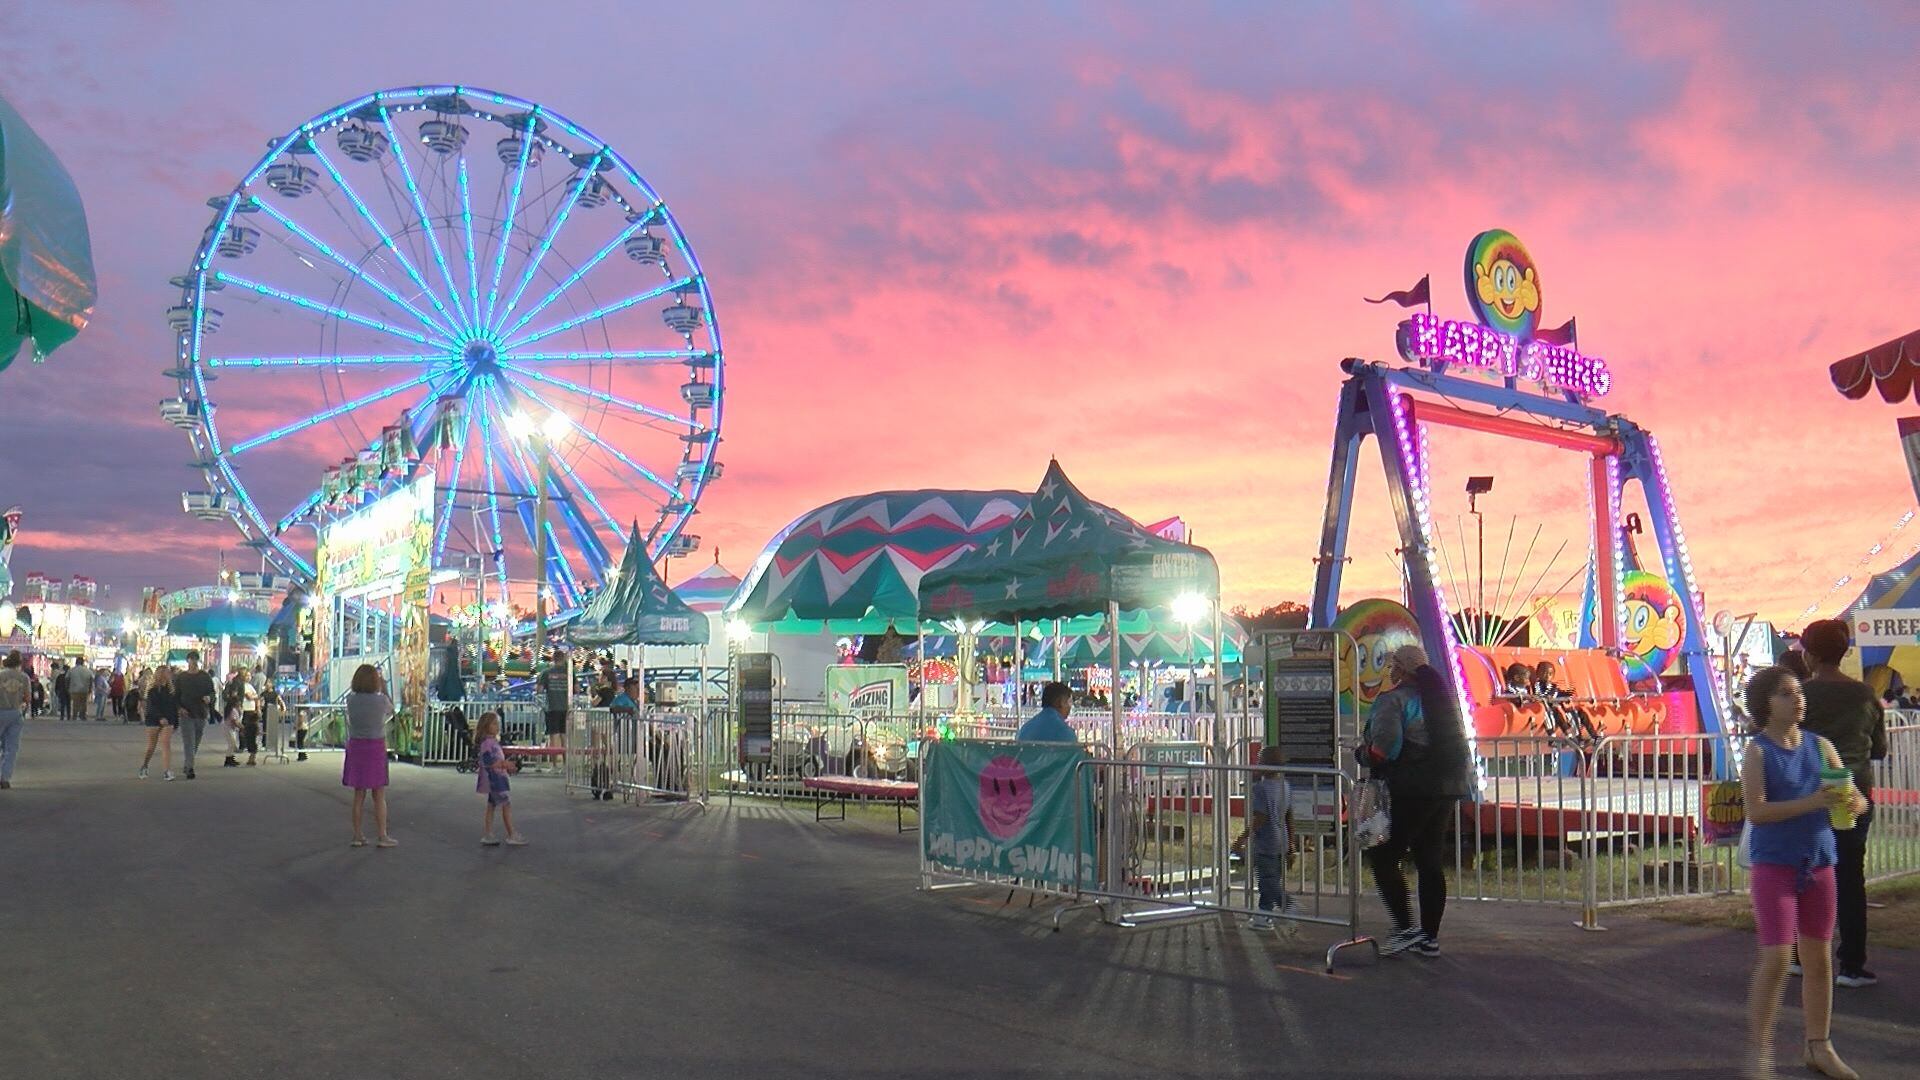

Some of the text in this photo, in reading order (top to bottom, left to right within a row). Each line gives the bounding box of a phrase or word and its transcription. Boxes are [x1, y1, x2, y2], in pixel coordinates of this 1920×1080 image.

[1412, 313, 1518, 378] HAPPY
[1152, 552, 1199, 579] ENTER
[659, 617, 690, 632] ENTER
[850, 690, 888, 709] AMAZING
[1157, 750, 1198, 763] ENTER
[1008, 844, 1093, 881] SWING
